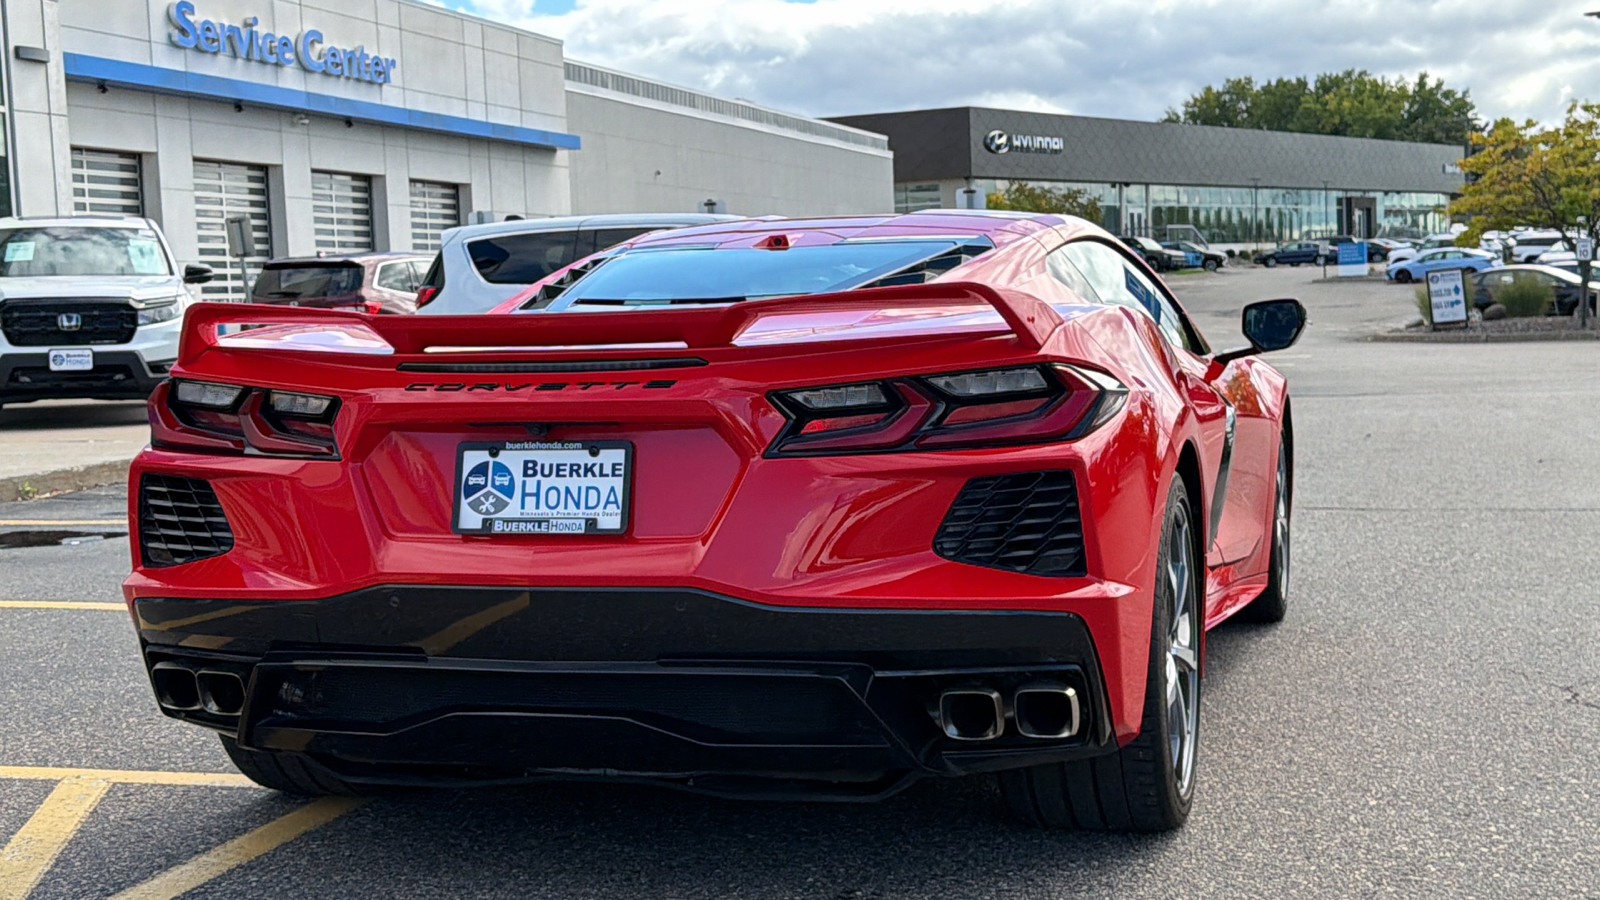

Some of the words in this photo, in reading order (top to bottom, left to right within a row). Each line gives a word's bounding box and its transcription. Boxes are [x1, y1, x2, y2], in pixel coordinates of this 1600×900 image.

[169, 0, 294, 66] Service
[299, 29, 396, 84] Center
[1012, 134, 1064, 150] HYUNDAI
[404, 380, 677, 391] CORVETTE
[505, 441, 582, 449] buerklehonda.com
[522, 459, 623, 478] BUERKLE
[520, 479, 620, 510] HONDA
[493, 520, 549, 531] BUERKLE
[550, 520, 583, 531] HONDA
